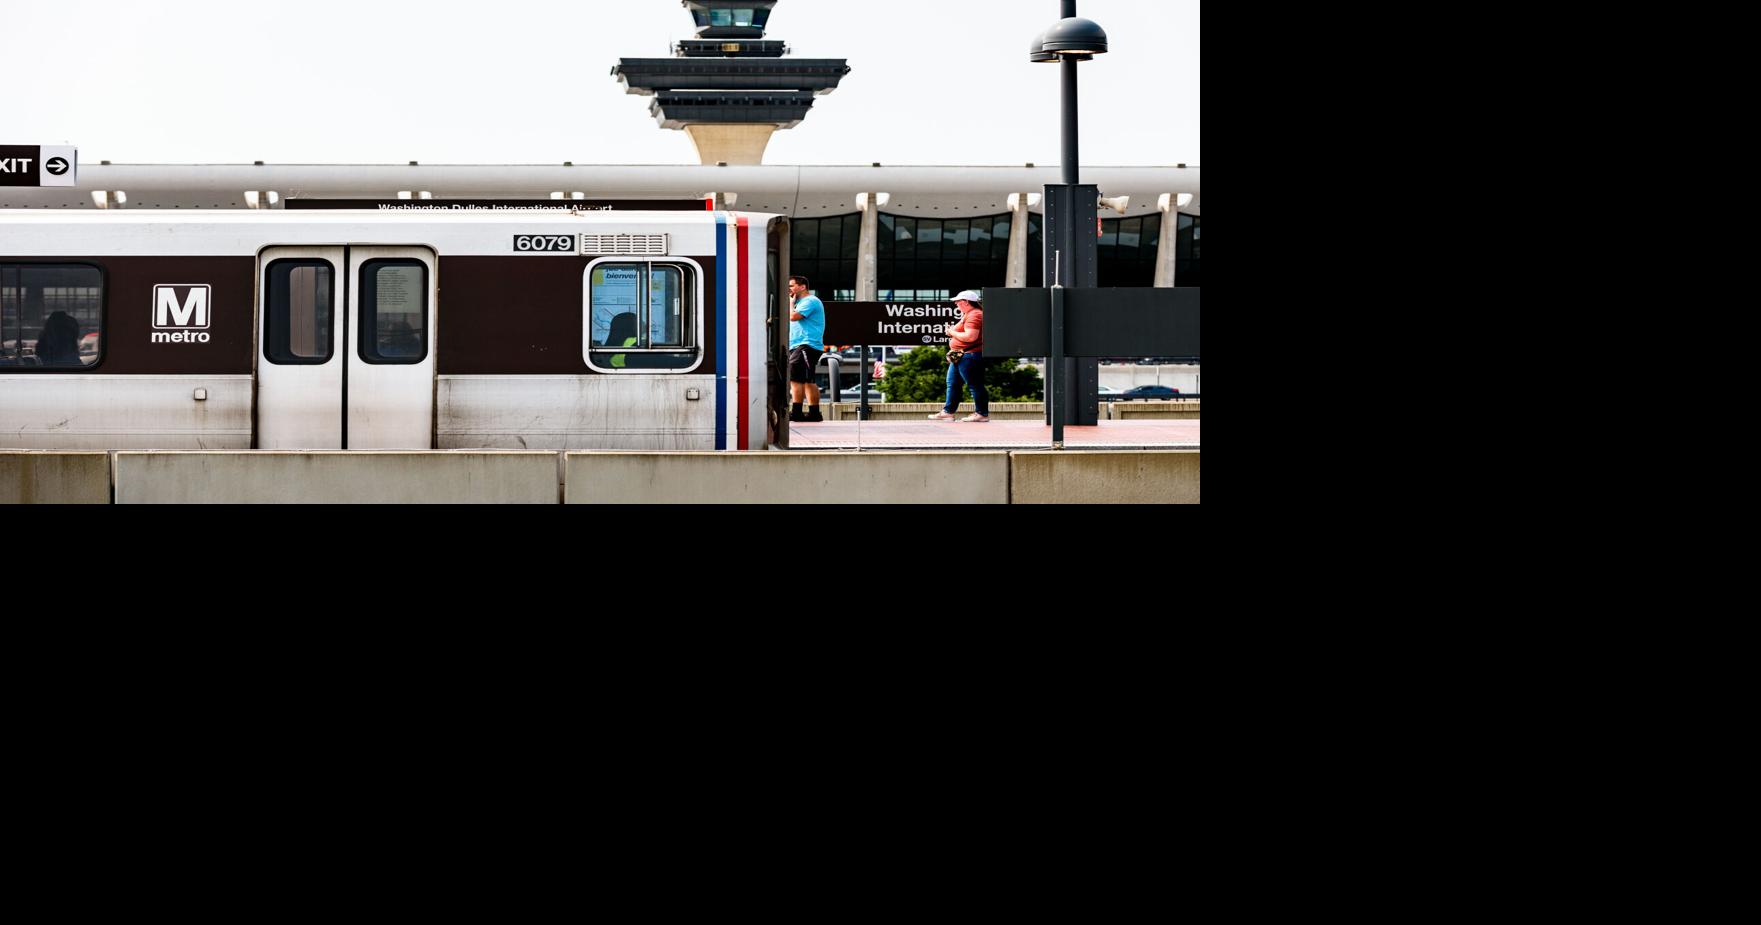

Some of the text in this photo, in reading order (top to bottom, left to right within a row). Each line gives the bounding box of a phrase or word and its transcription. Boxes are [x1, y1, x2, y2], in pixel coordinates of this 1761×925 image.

[0, 158, 33, 173] XIT
[516, 235, 572, 251] 6079
[156, 287, 207, 326] M
[885, 304, 964, 320] Washing
[151, 329, 210, 343] metro
